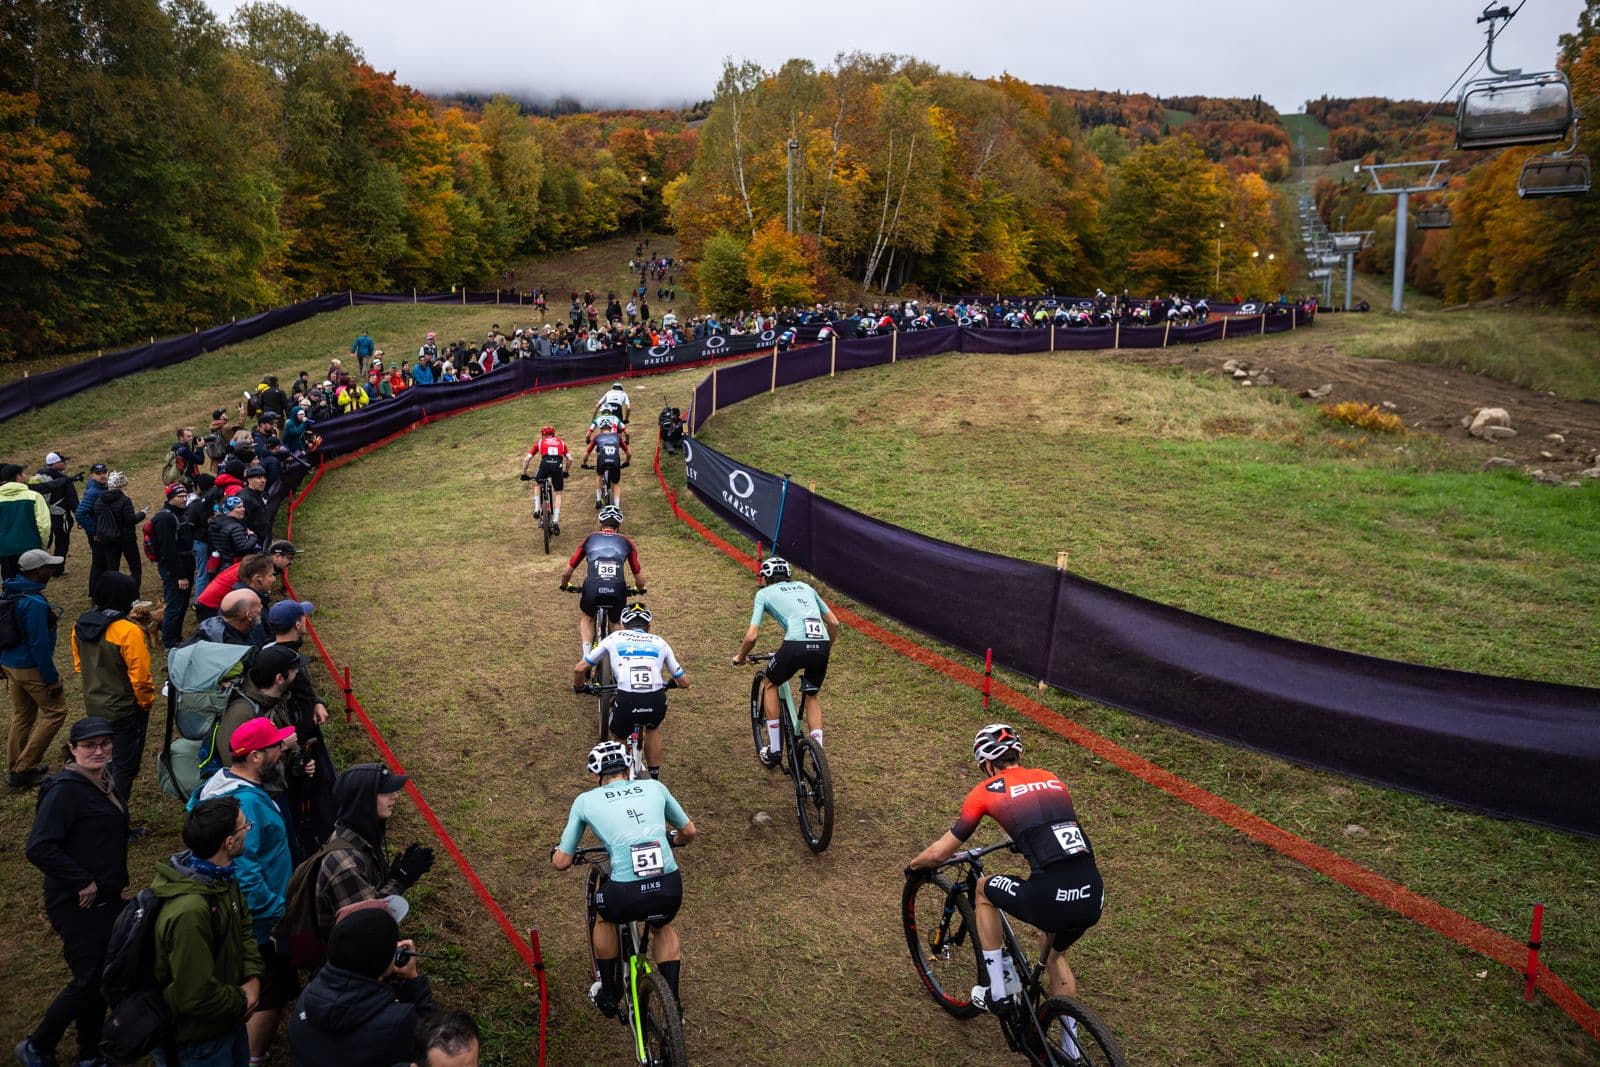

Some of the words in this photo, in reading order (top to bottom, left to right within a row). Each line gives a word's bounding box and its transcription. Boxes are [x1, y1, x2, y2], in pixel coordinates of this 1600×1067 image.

[701, 347, 730, 356] OAKLEY
[644, 356, 674, 365] OAKLEY
[722, 490, 757, 520] OAKLEY
[600, 566, 614, 574] 36
[809, 624, 821, 633] 14
[634, 672, 650, 683] 15
[604, 786, 644, 799] BIXS
[1010, 780, 1063, 798] BMC
[1061, 830, 1082, 846] 24
[637, 852, 658, 868] 51
[640, 881, 661, 891] BIXS
[989, 875, 1021, 897] BMC
[1055, 884, 1091, 902] BMC
